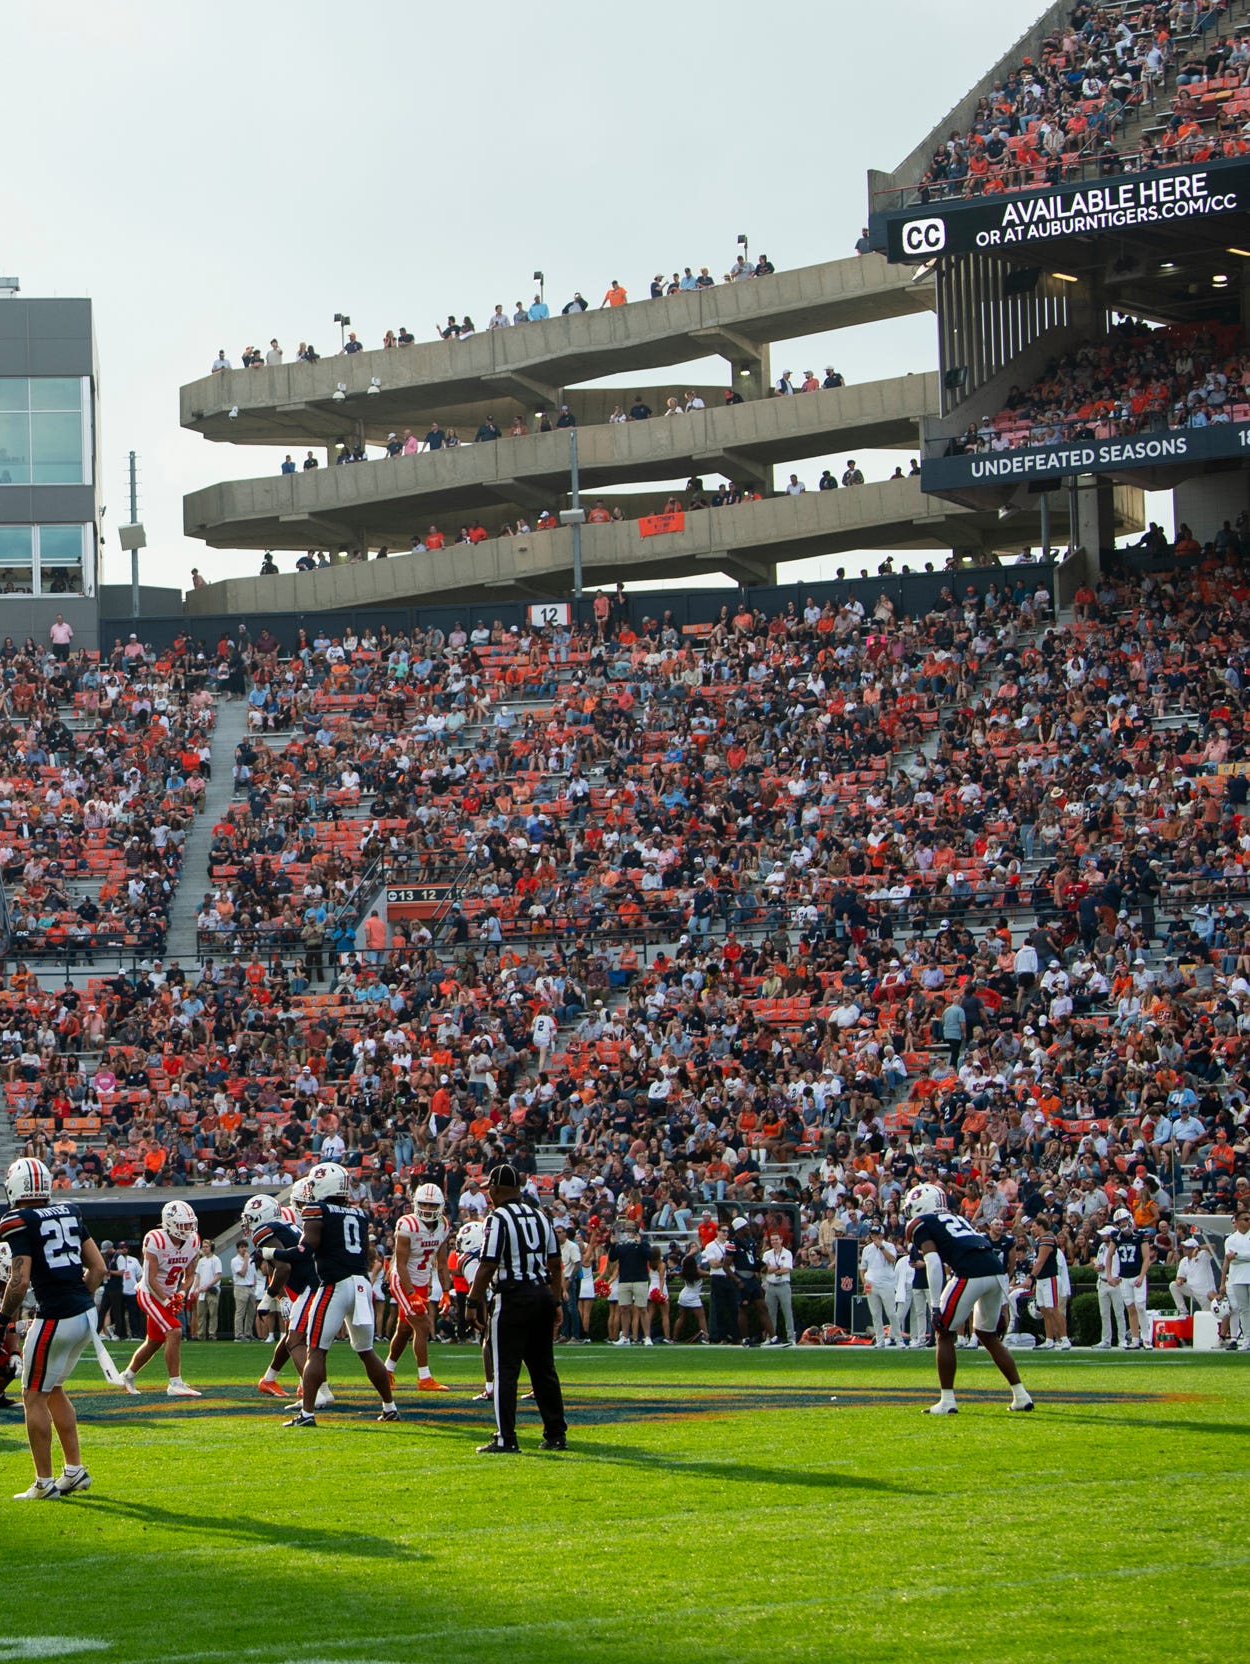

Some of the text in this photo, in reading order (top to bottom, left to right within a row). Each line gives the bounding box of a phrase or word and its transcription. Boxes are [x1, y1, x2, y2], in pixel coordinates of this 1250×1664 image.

[1002, 172, 1208, 227] AVAILABLE HERE
[906, 223, 941, 250] CC
[976, 193, 1238, 247] OR AT AUBURNTIGERS.COM/CC
[971, 437, 1187, 478] UNDEFEATED SEASONS
[540, 607, 558, 623] 12
[398, 890, 414, 901] 13
[421, 889, 436, 900] 12
[39, 1216, 82, 1269] 25
[343, 1215, 362, 1254] 0
[517, 1216, 537, 1251] U
[417, 1249, 435, 1270] 7
[1118, 1245, 1136, 1263] 37
